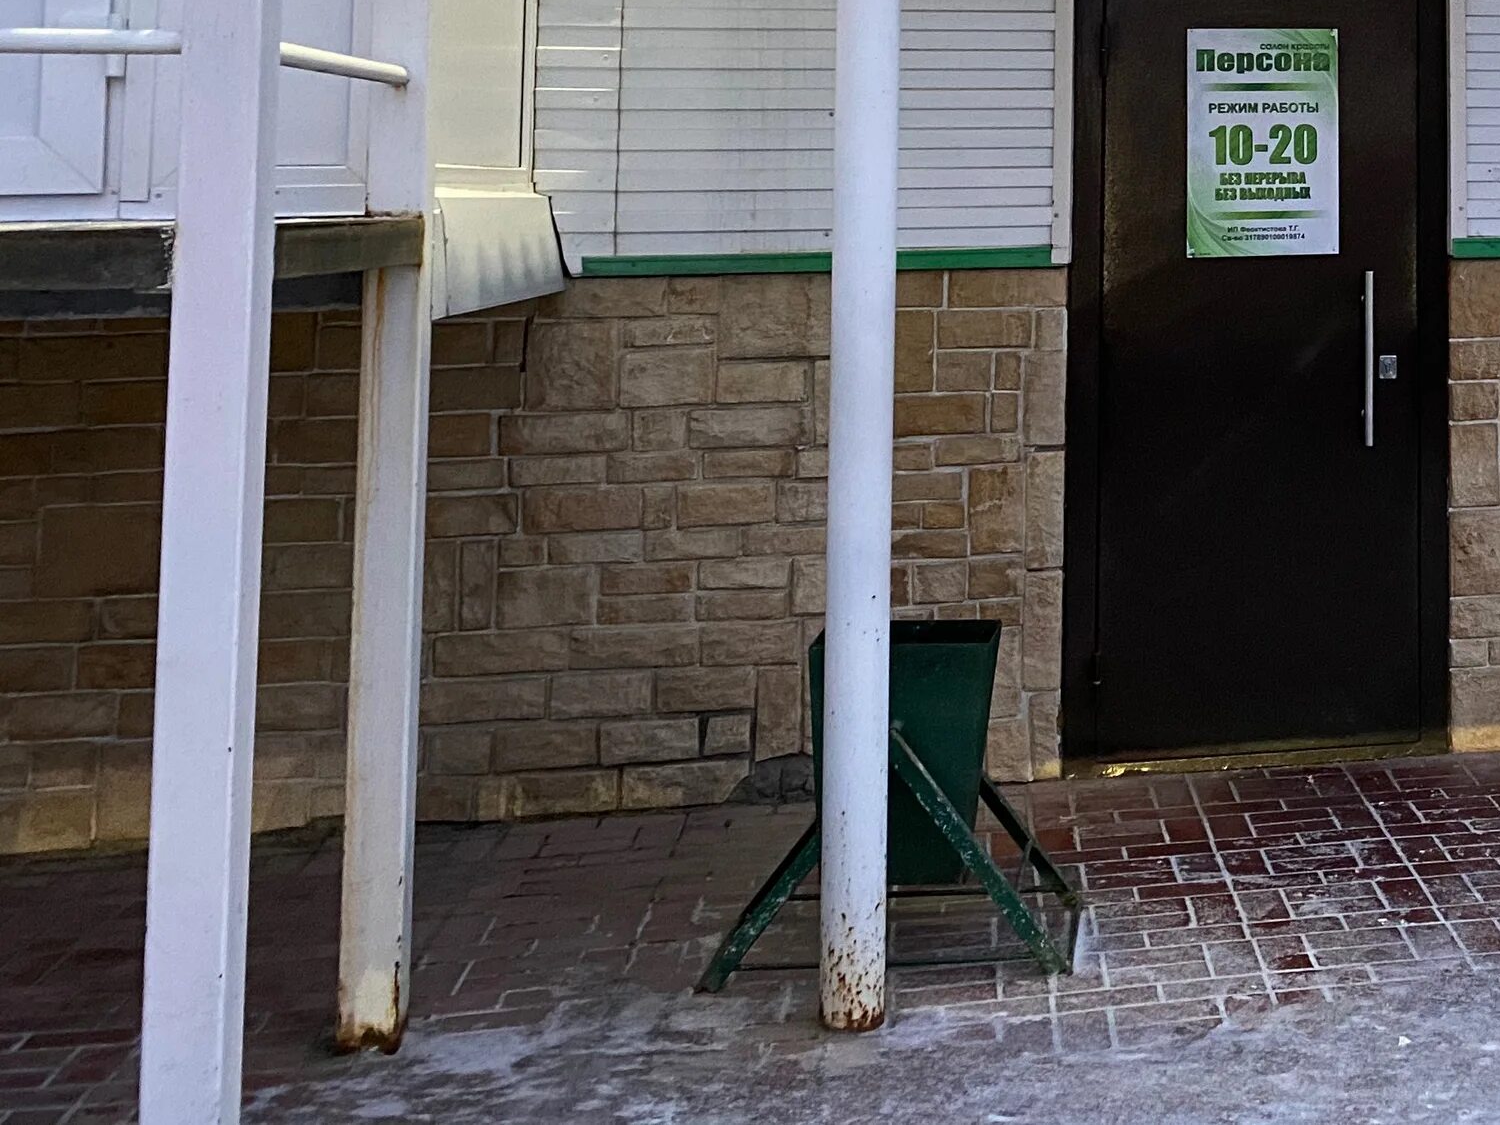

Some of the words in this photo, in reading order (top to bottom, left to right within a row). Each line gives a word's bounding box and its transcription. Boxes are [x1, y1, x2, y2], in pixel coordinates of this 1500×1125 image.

[1196, 49, 1330, 74] Персона
[1208, 103, 1258, 114] РЕЖИМ
[1262, 102, 1319, 114] РАБОТЫ
[1208, 124, 1318, 165] 10-20
[1219, 172, 1241, 186] БЕЗ
[1244, 171, 1306, 185] ПЕРЕРЫВА
[1214, 187, 1237, 201] БЕЗ
[1239, 187, 1311, 202] ВЫХОДНЫХ
